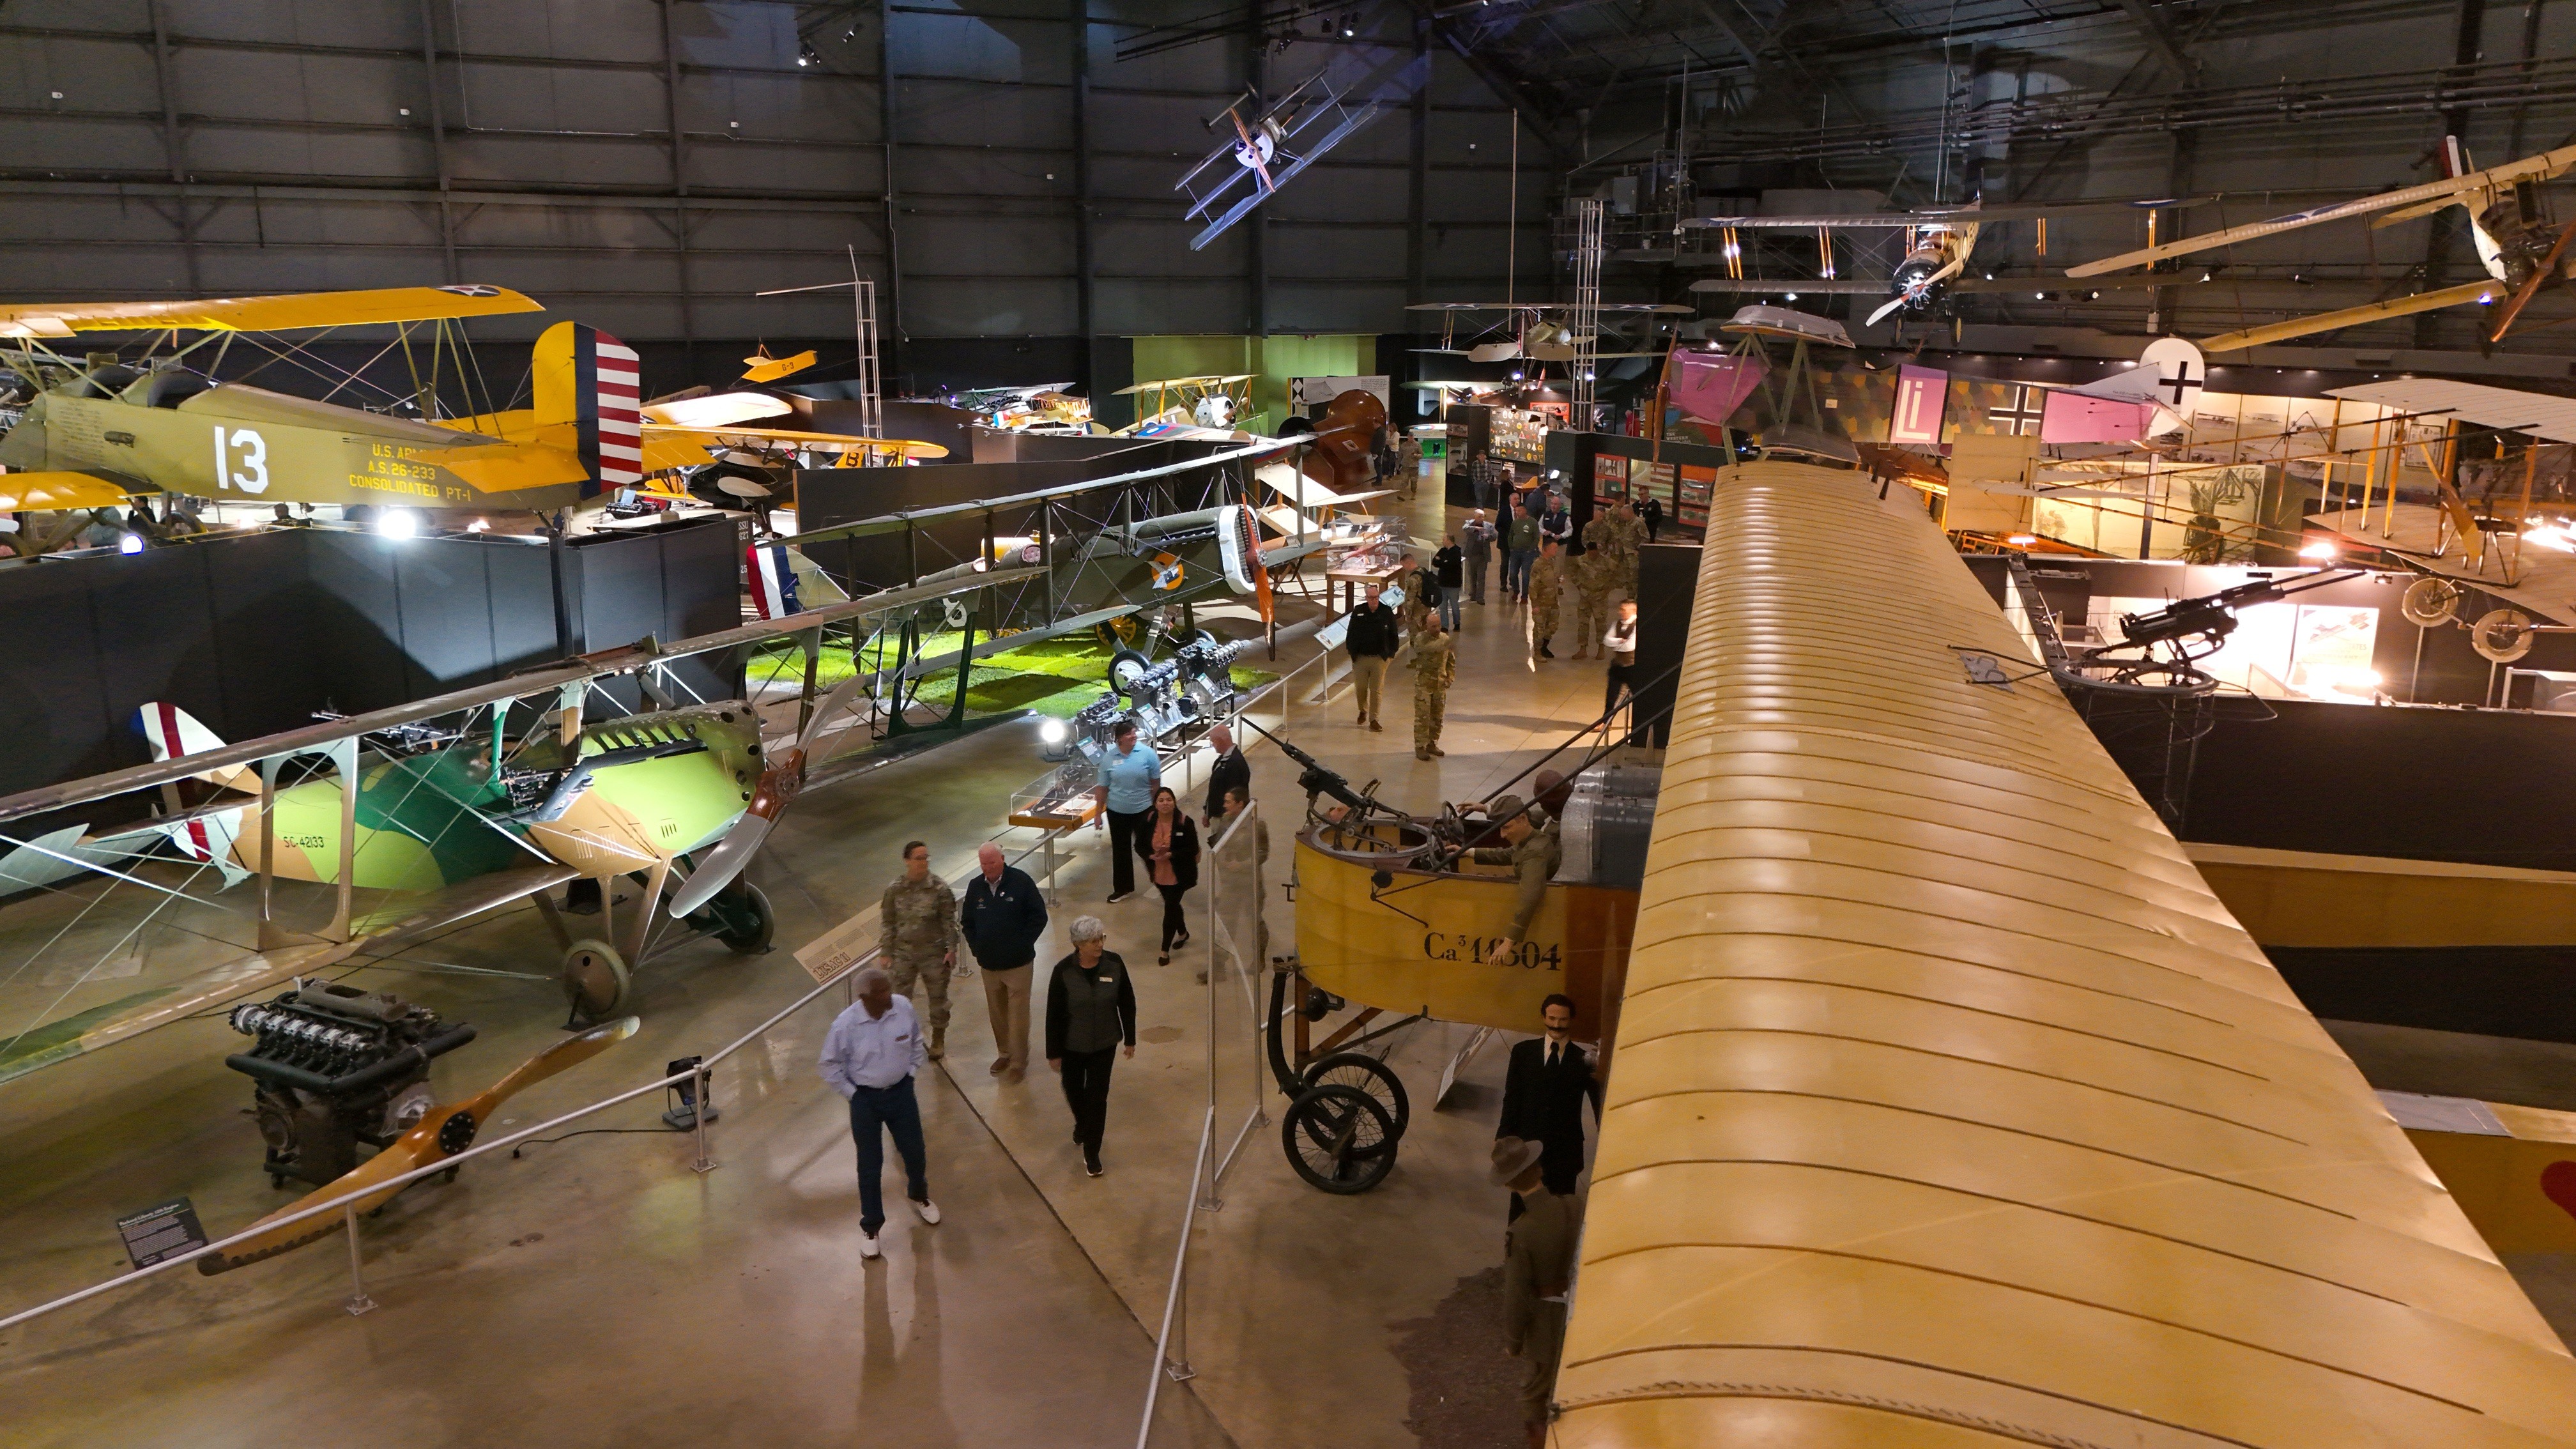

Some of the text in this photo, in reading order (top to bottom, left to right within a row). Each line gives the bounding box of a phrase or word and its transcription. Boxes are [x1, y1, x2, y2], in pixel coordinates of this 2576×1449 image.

[1896, 379, 1931, 440] Li
[214, 425, 269, 494] 13
[372, 443, 395, 459] U.S.
[845, 452, 860, 468] B
[368, 459, 436, 480] A.S. 26-233
[349, 474, 471, 502] CONSOLIDATED PT-1
[283, 836, 325, 848] SC-42133
